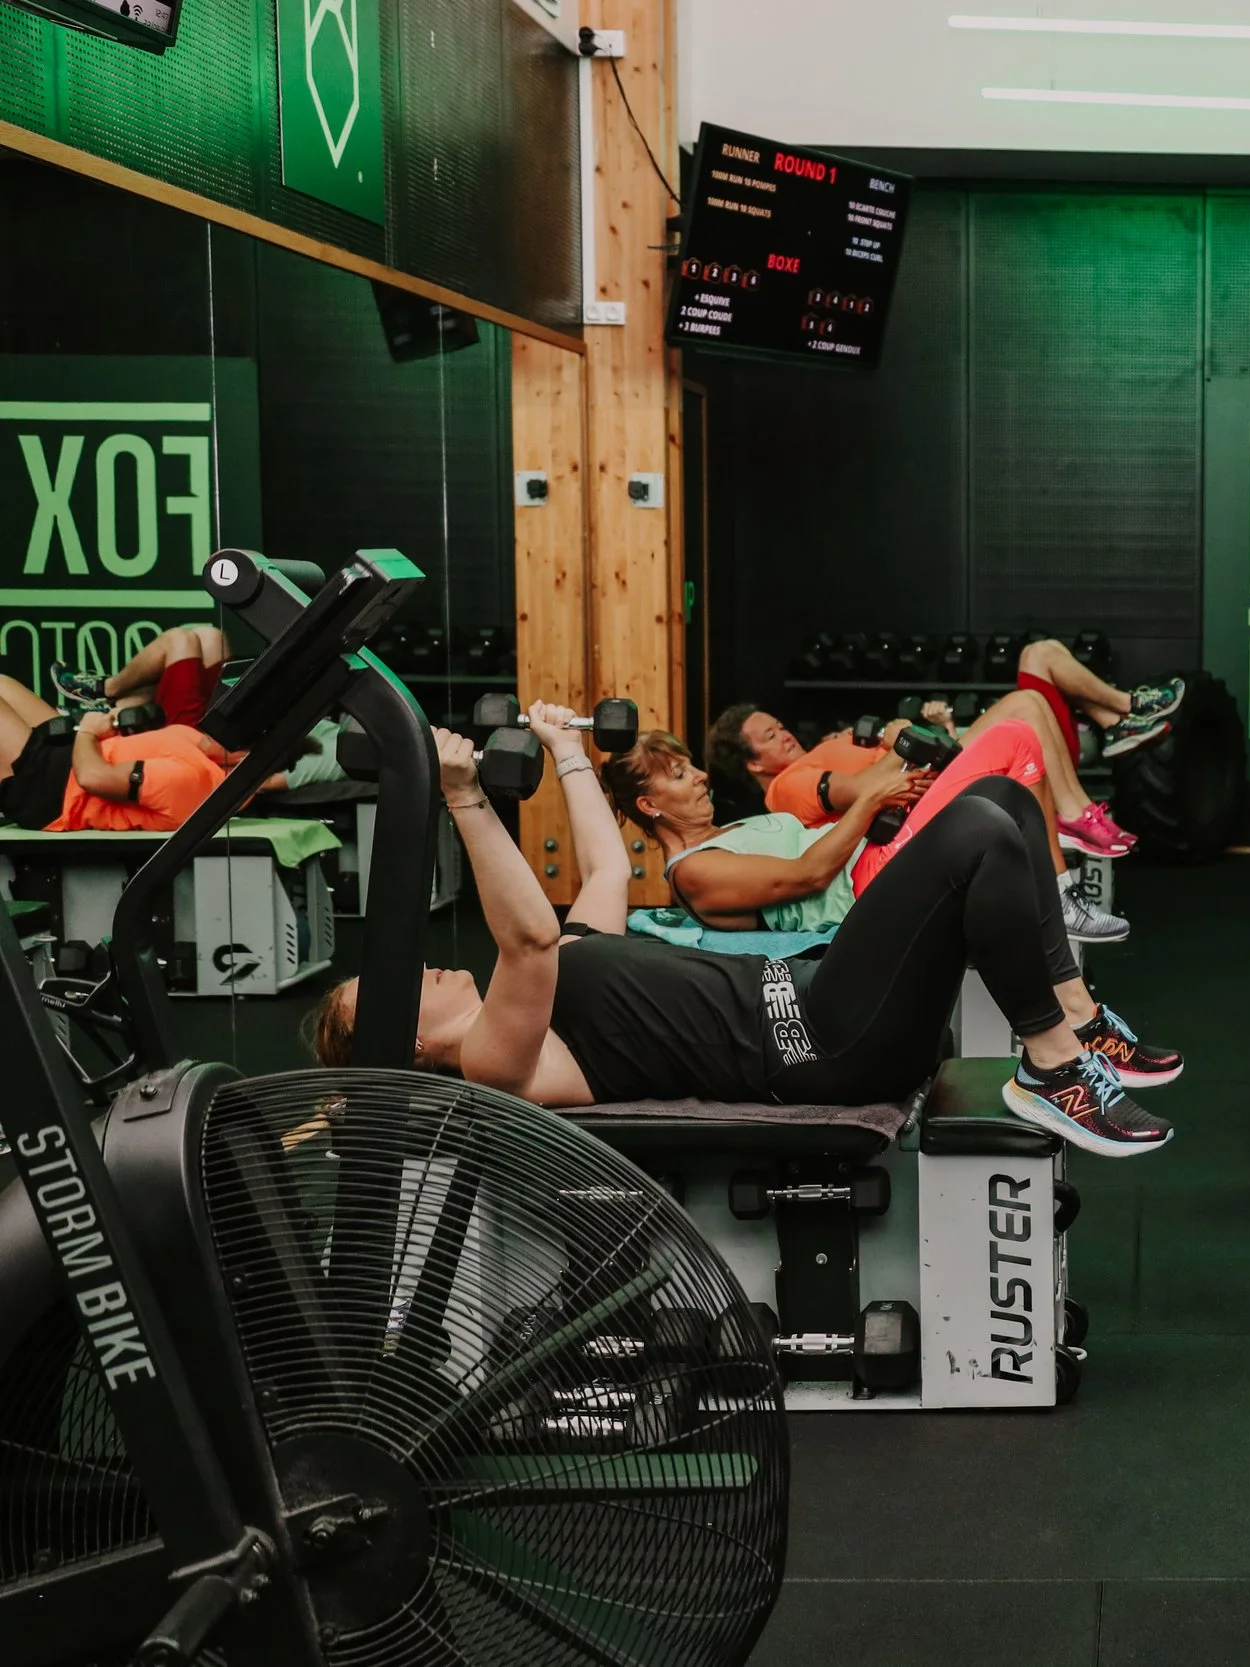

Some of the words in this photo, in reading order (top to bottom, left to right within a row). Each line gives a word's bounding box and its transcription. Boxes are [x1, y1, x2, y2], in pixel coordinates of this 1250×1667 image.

[721, 143, 761, 163] RUNNER
[774, 152, 826, 180] ROUND
[829, 166, 838, 184] 1
[711, 170, 729, 181] 100M
[729, 174, 743, 184] RUN
[744, 178, 752, 187] 10
[752, 179, 777, 192] POMPES
[869, 178, 895, 193] BENCH
[724, 200, 739, 211] RUN
[747, 206, 771, 218] SQUATS
[854, 215, 873, 225] FRONT
[872, 219, 893, 230] SQUATS
[767, 253, 800, 273] BOXE
[712, 268, 719, 277] 2
[700, 293, 731, 307] ESQUIVE
[680, 305, 687, 315] 2
[687, 307, 708, 318] COUP
[708, 309, 733, 322] COUDE
[684, 322, 690, 331] 3
[690, 322, 721, 335] BURPEES
[812, 340, 818, 349] 2
[817, 341, 836, 351] COUP
[836, 344, 861, 354] GENOUX
[219, 563, 230, 579] L
[17, 1125, 113, 1278] STORM
[76, 1281, 156, 1390] BIKE
[988, 1173, 1033, 1384] RUSTER
